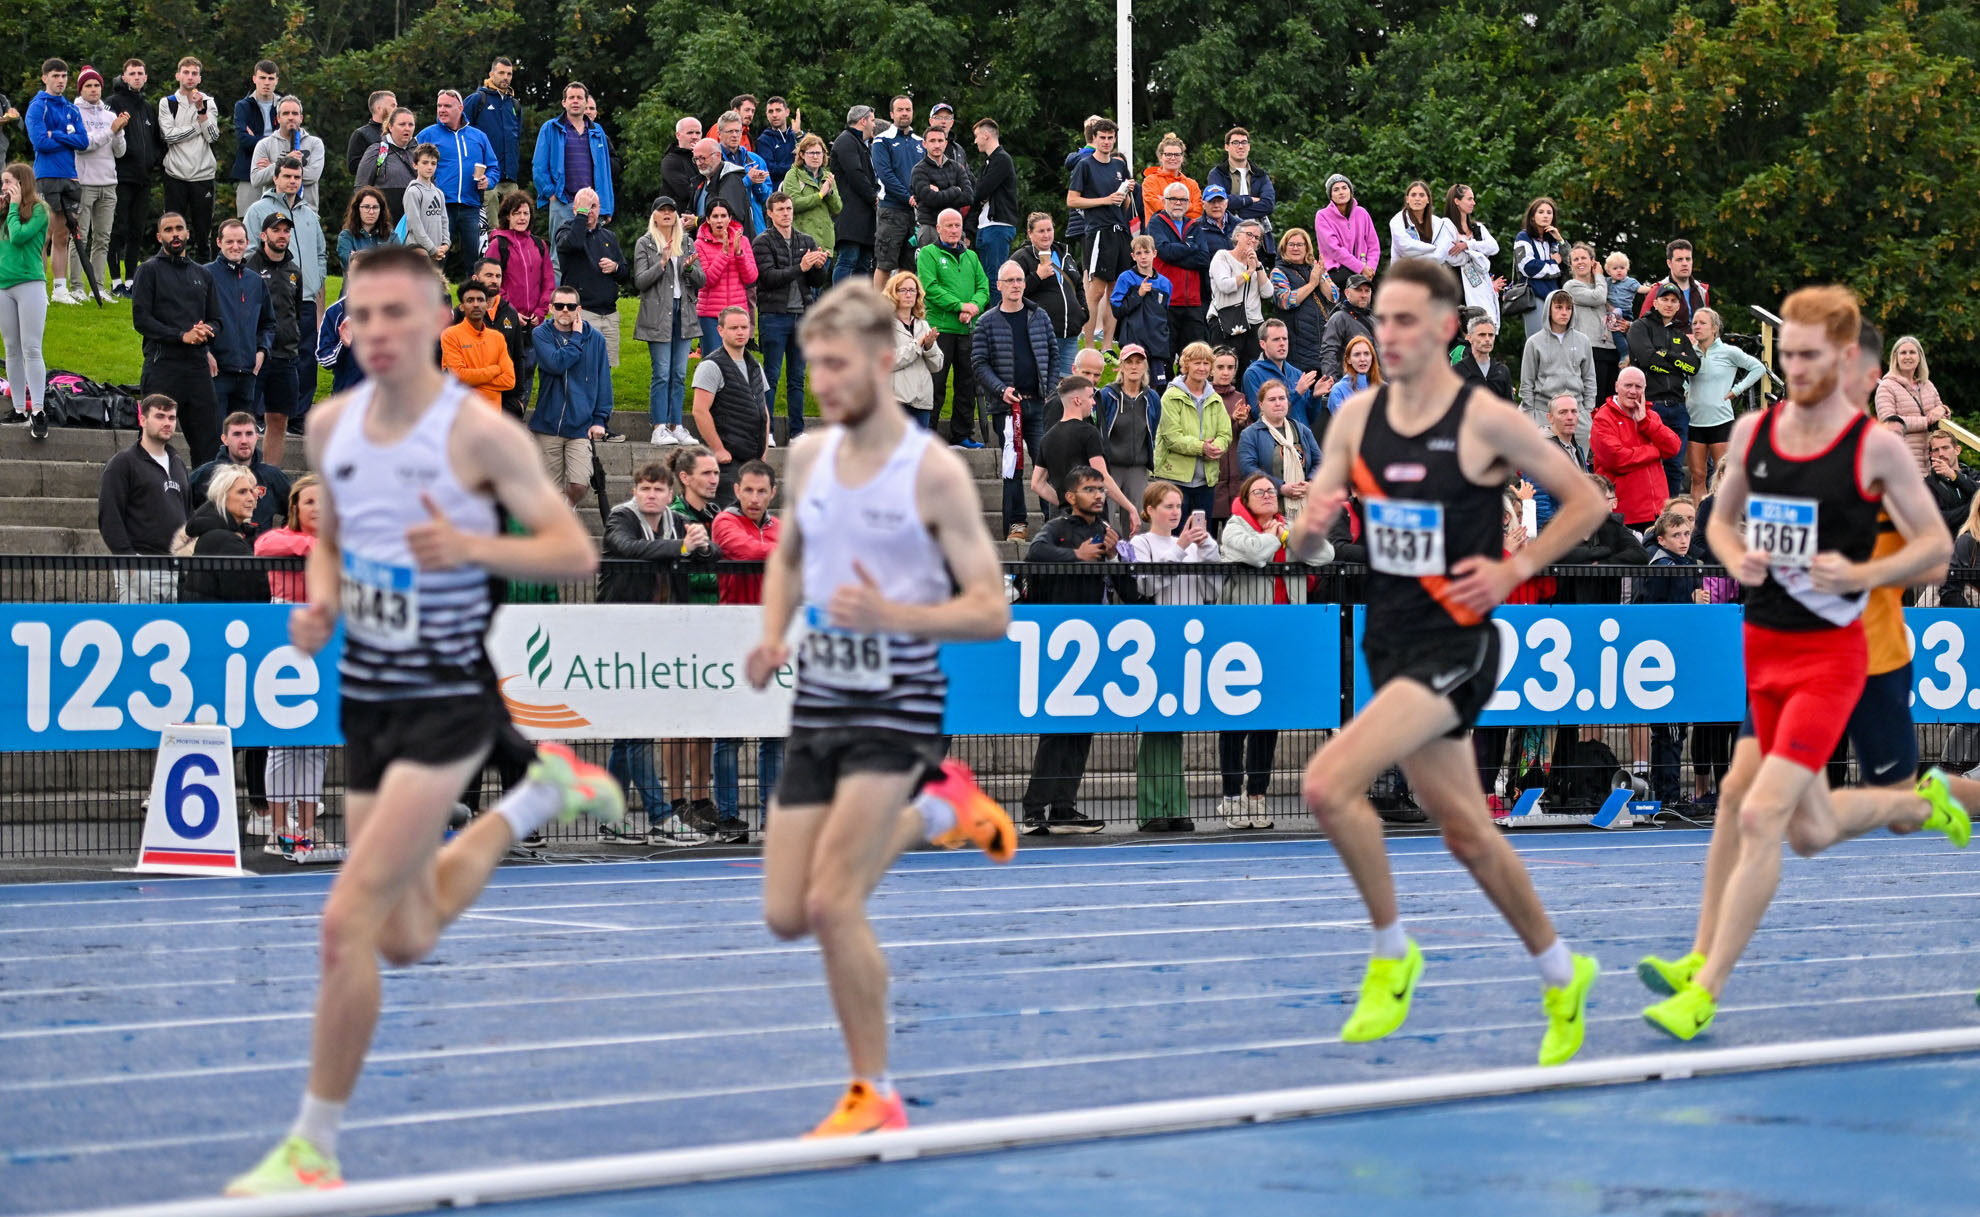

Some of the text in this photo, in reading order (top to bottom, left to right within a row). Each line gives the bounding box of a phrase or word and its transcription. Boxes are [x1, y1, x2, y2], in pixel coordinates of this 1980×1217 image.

[1375, 527, 1433, 562] 1337
[1755, 523, 1808, 555] 1367
[11, 619, 320, 732] 123.ie
[564, 651, 735, 690] Athletics
[807, 632, 882, 672] 1336
[1006, 618, 1263, 717] 123.ie
[1482, 618, 1676, 711] 23.ie
[164, 753, 220, 840] 6
